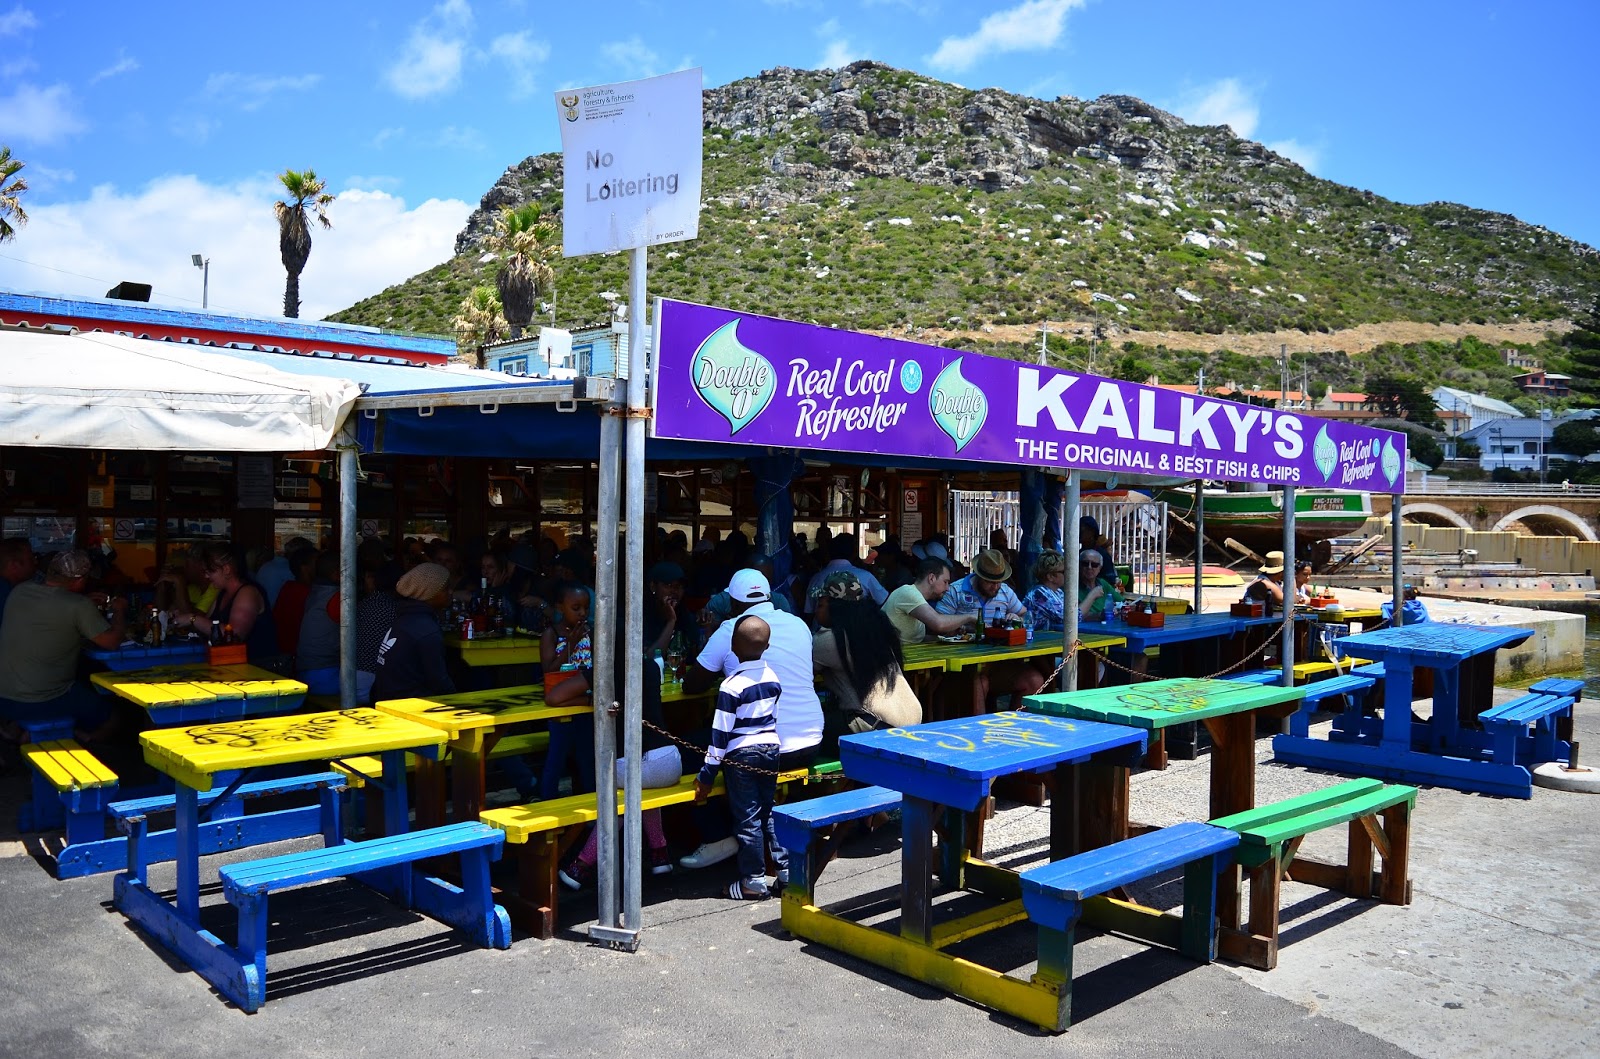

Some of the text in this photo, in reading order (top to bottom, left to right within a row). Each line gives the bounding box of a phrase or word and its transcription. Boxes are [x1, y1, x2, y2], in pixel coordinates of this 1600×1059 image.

[583, 97, 606, 106] forestry
[612, 93, 635, 103] fisheries
[586, 149, 614, 171] No
[586, 172, 679, 203] Loitering
[664, 230, 685, 239] ORDER
[698, 356, 770, 389] Double
[786, 357, 896, 399] Real Cool
[934, 387, 983, 416] Double
[1016, 367, 1303, 459] KALKY'S
[795, 394, 908, 441] Refresher
[1015, 438, 1301, 482] THE ORIGINAL & BEST FISH & CHIPS
[1339, 439, 1356, 463] Real
[1356, 438, 1372, 460] Cool
[1341, 458, 1376, 486] Refresher
